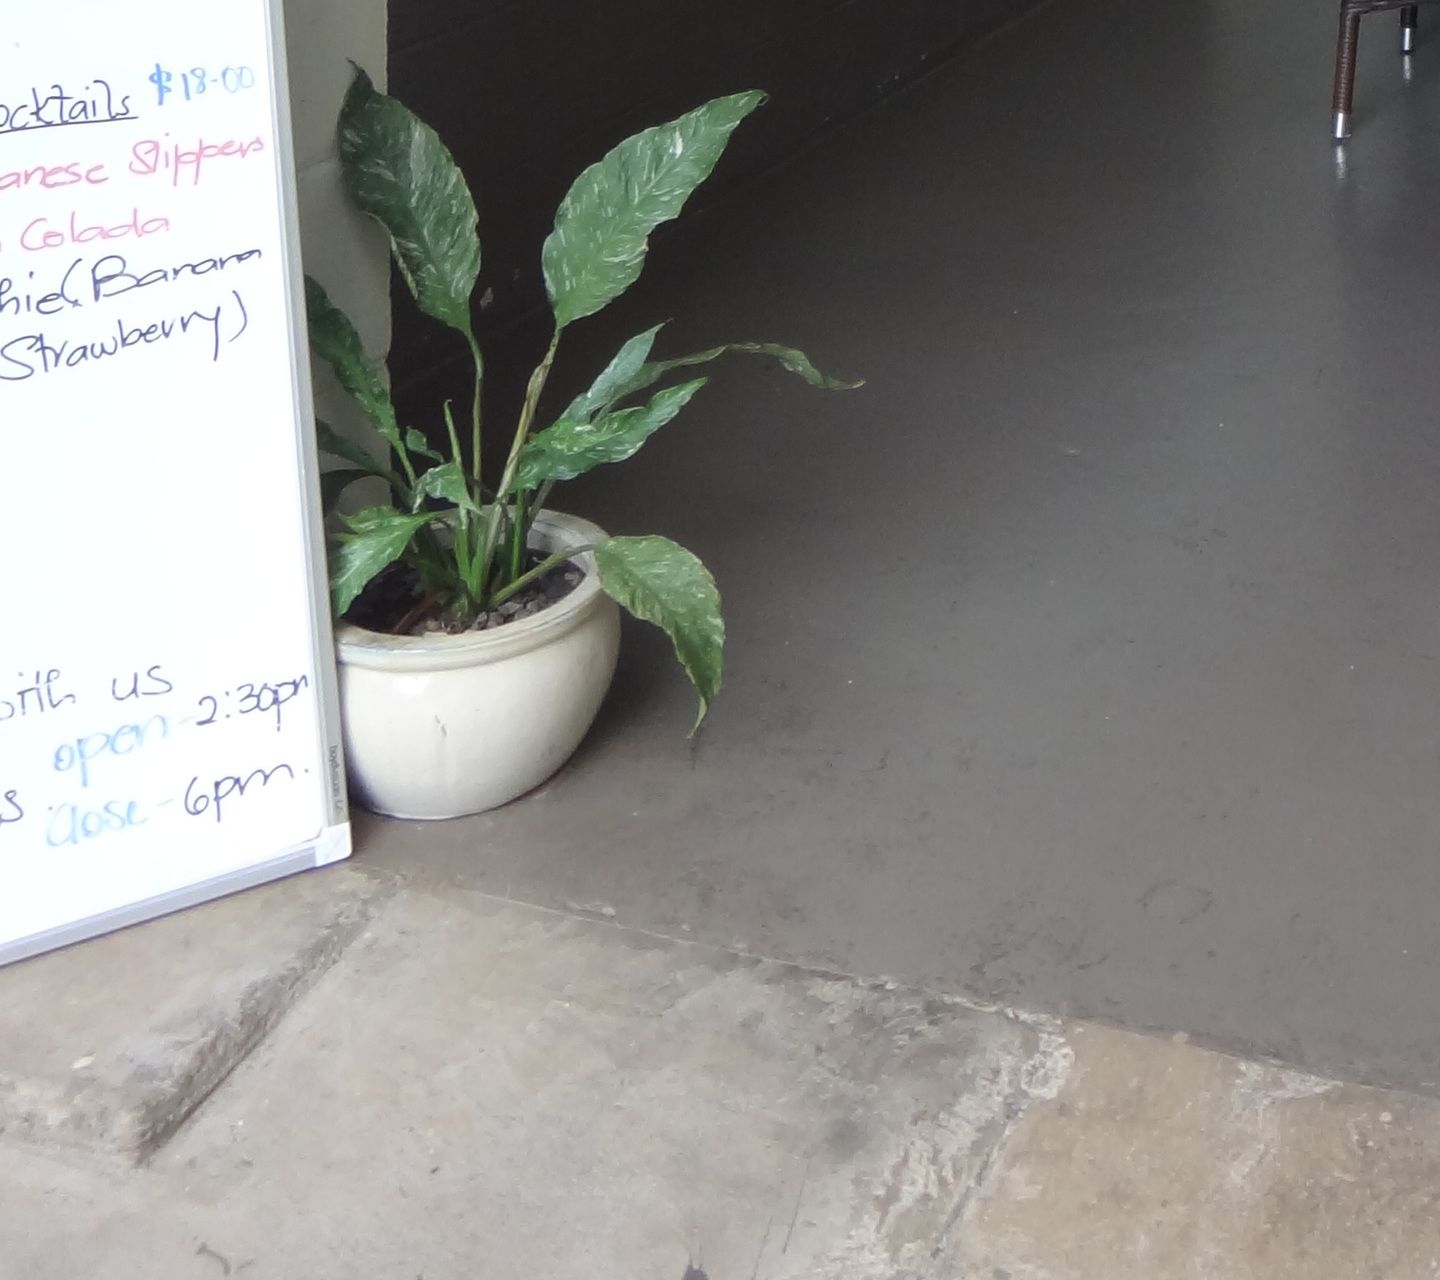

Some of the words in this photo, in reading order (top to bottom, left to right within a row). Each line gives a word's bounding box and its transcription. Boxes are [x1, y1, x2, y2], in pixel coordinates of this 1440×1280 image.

[20, 207, 170, 252] Colada
[111, 664, 174, 702] us
[53, 713, 169, 788] open
